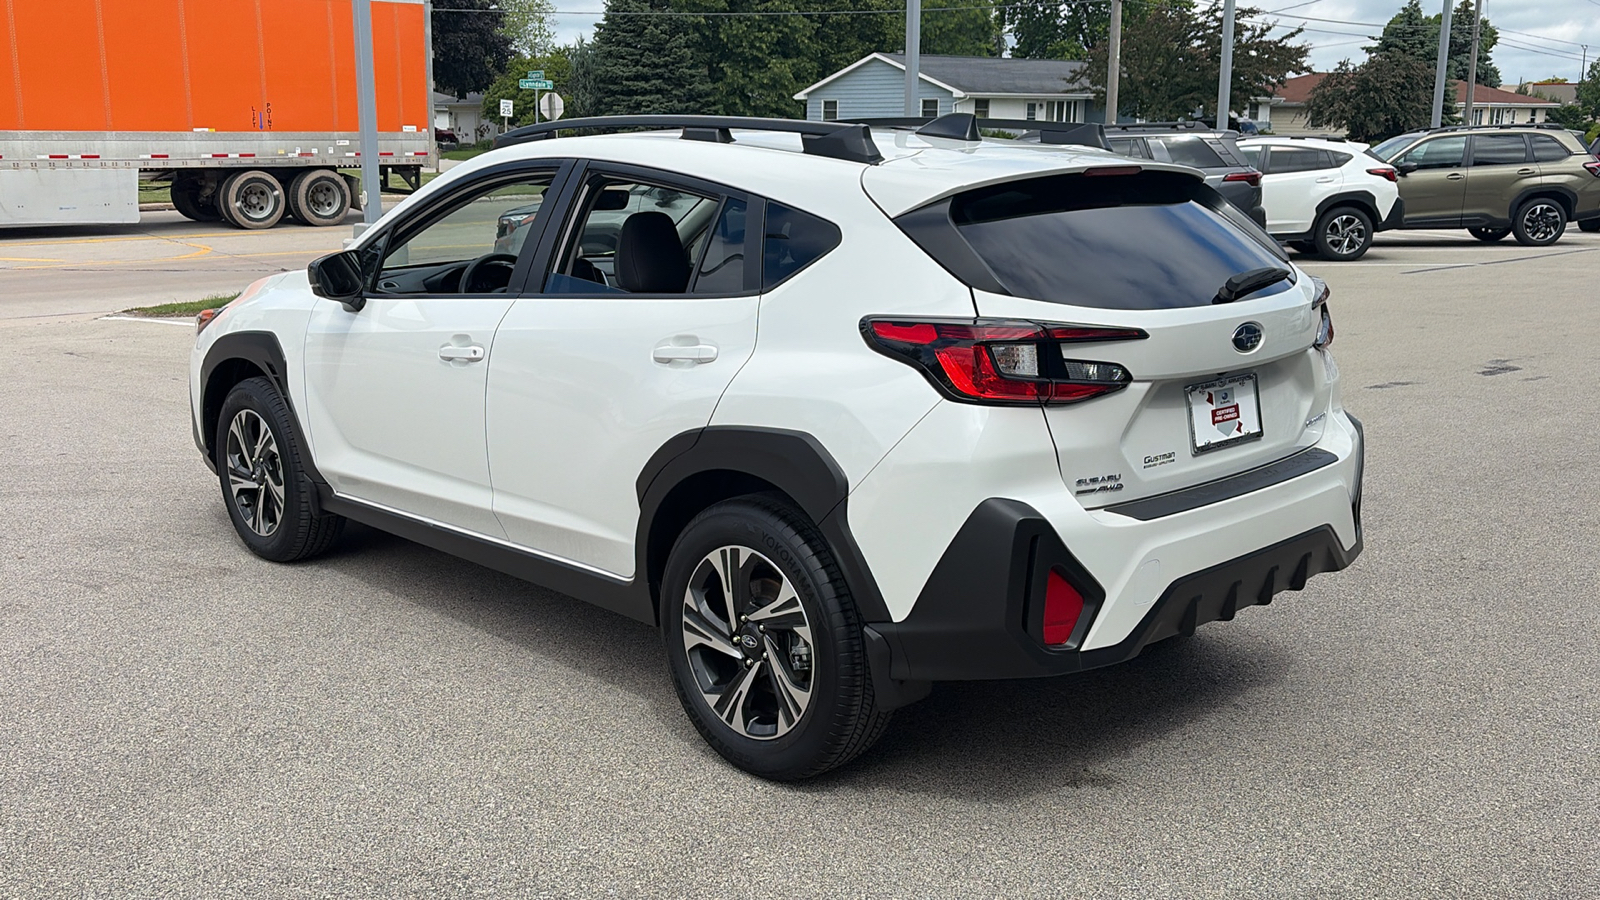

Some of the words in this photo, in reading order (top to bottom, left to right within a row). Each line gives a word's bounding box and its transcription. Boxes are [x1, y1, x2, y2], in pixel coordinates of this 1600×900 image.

[502, 107, 511, 115] 25
[1076, 473, 1121, 486] SUBARU
[1096, 483, 1124, 493] AWD
[761, 530, 815, 600] YOKOHAMA
